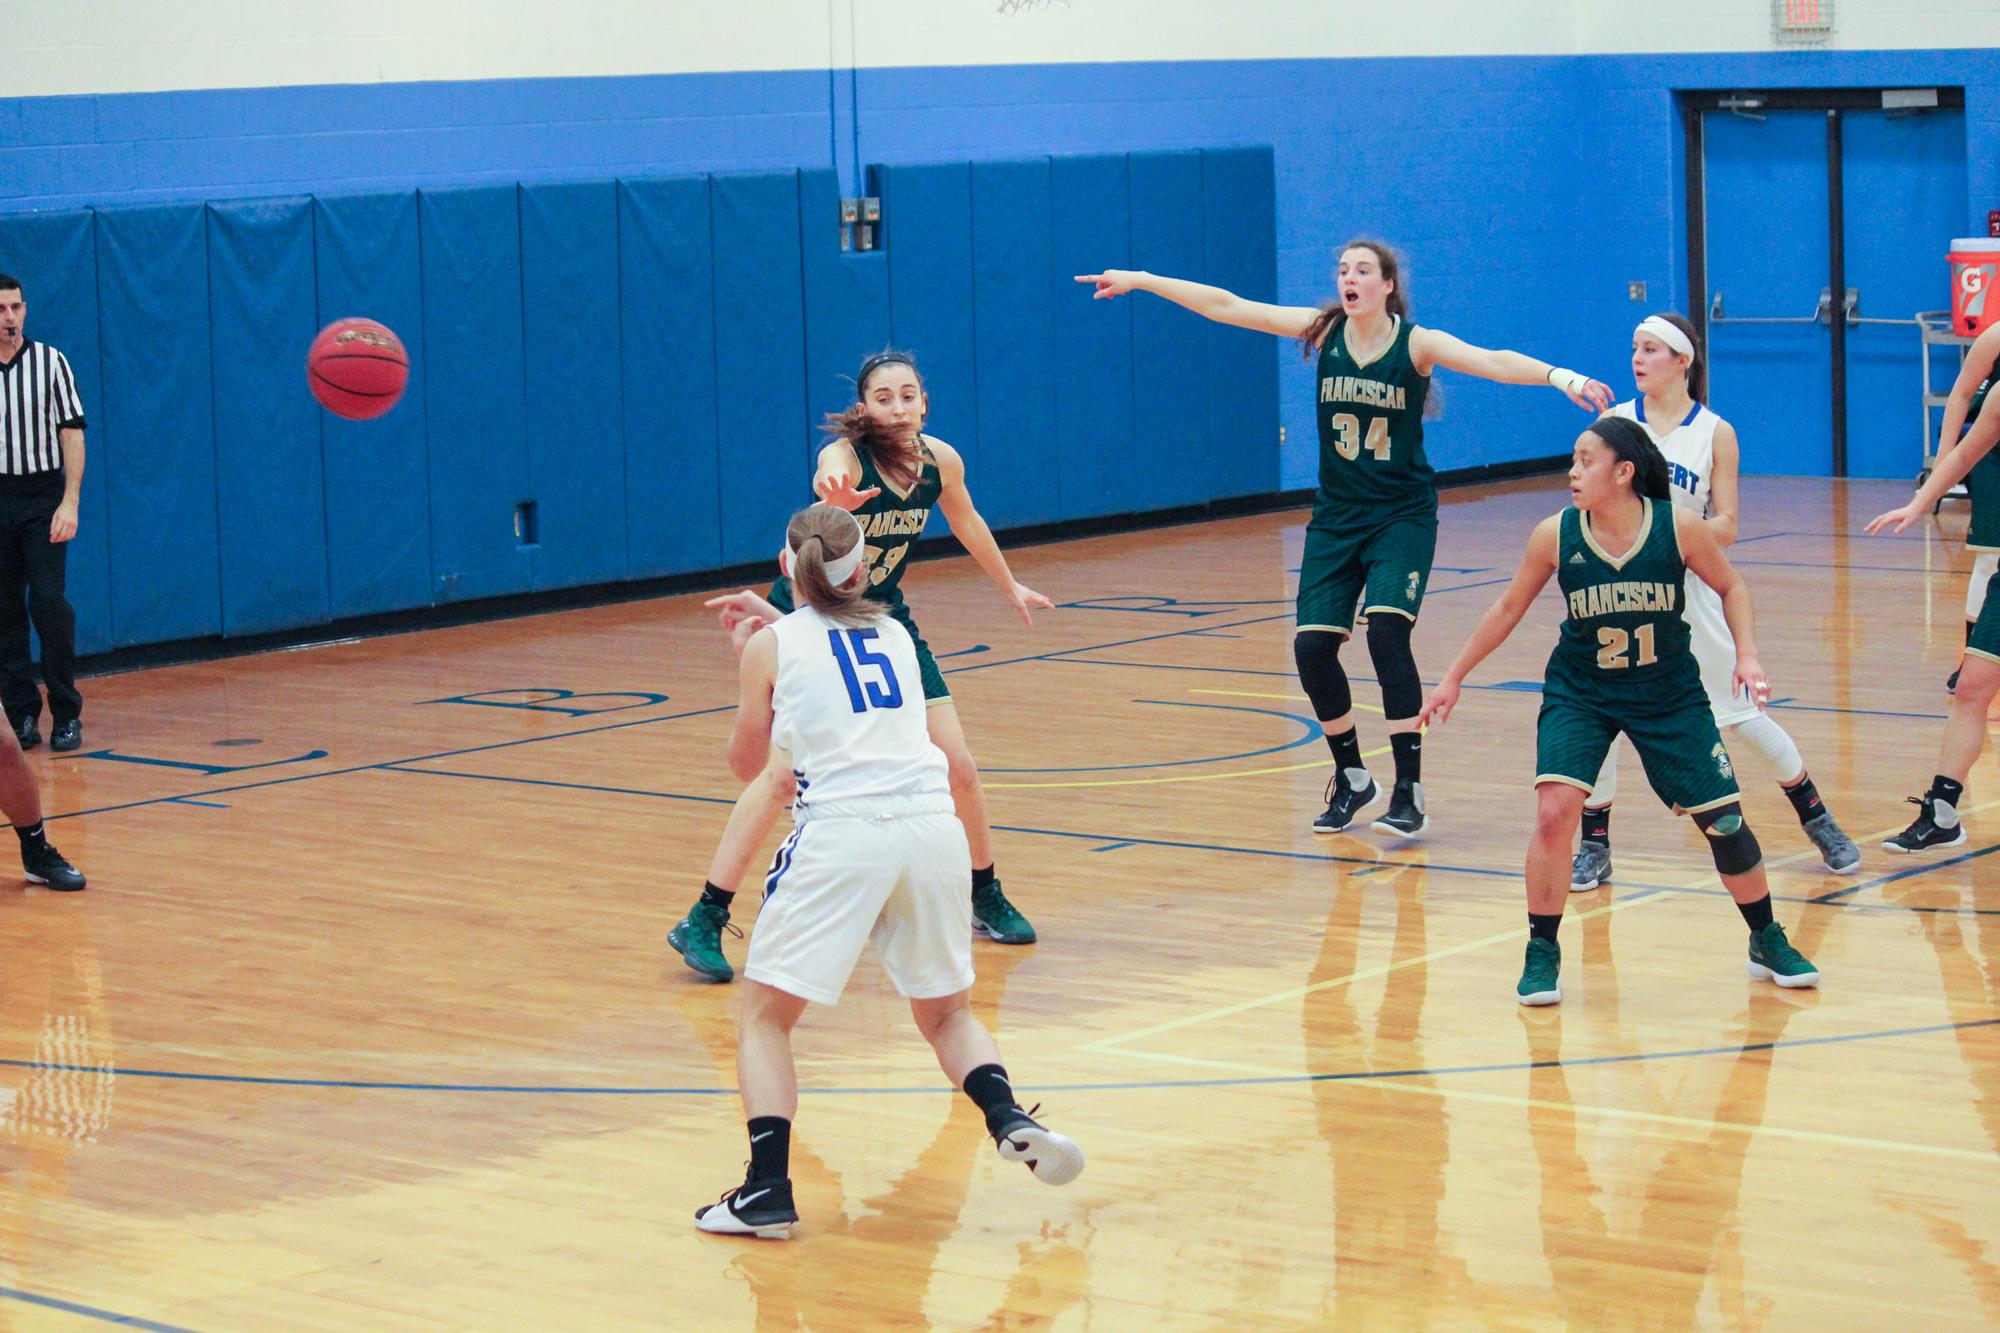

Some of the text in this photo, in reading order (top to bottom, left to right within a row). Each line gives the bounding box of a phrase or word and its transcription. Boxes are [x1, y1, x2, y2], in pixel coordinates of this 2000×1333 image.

[1961, 267, 1982, 293] G
[1321, 376, 1406, 410] FRANCISCAN
[1332, 412, 1392, 461] 34
[1597, 623, 1658, 669] 21
[827, 627, 903, 714] 15
